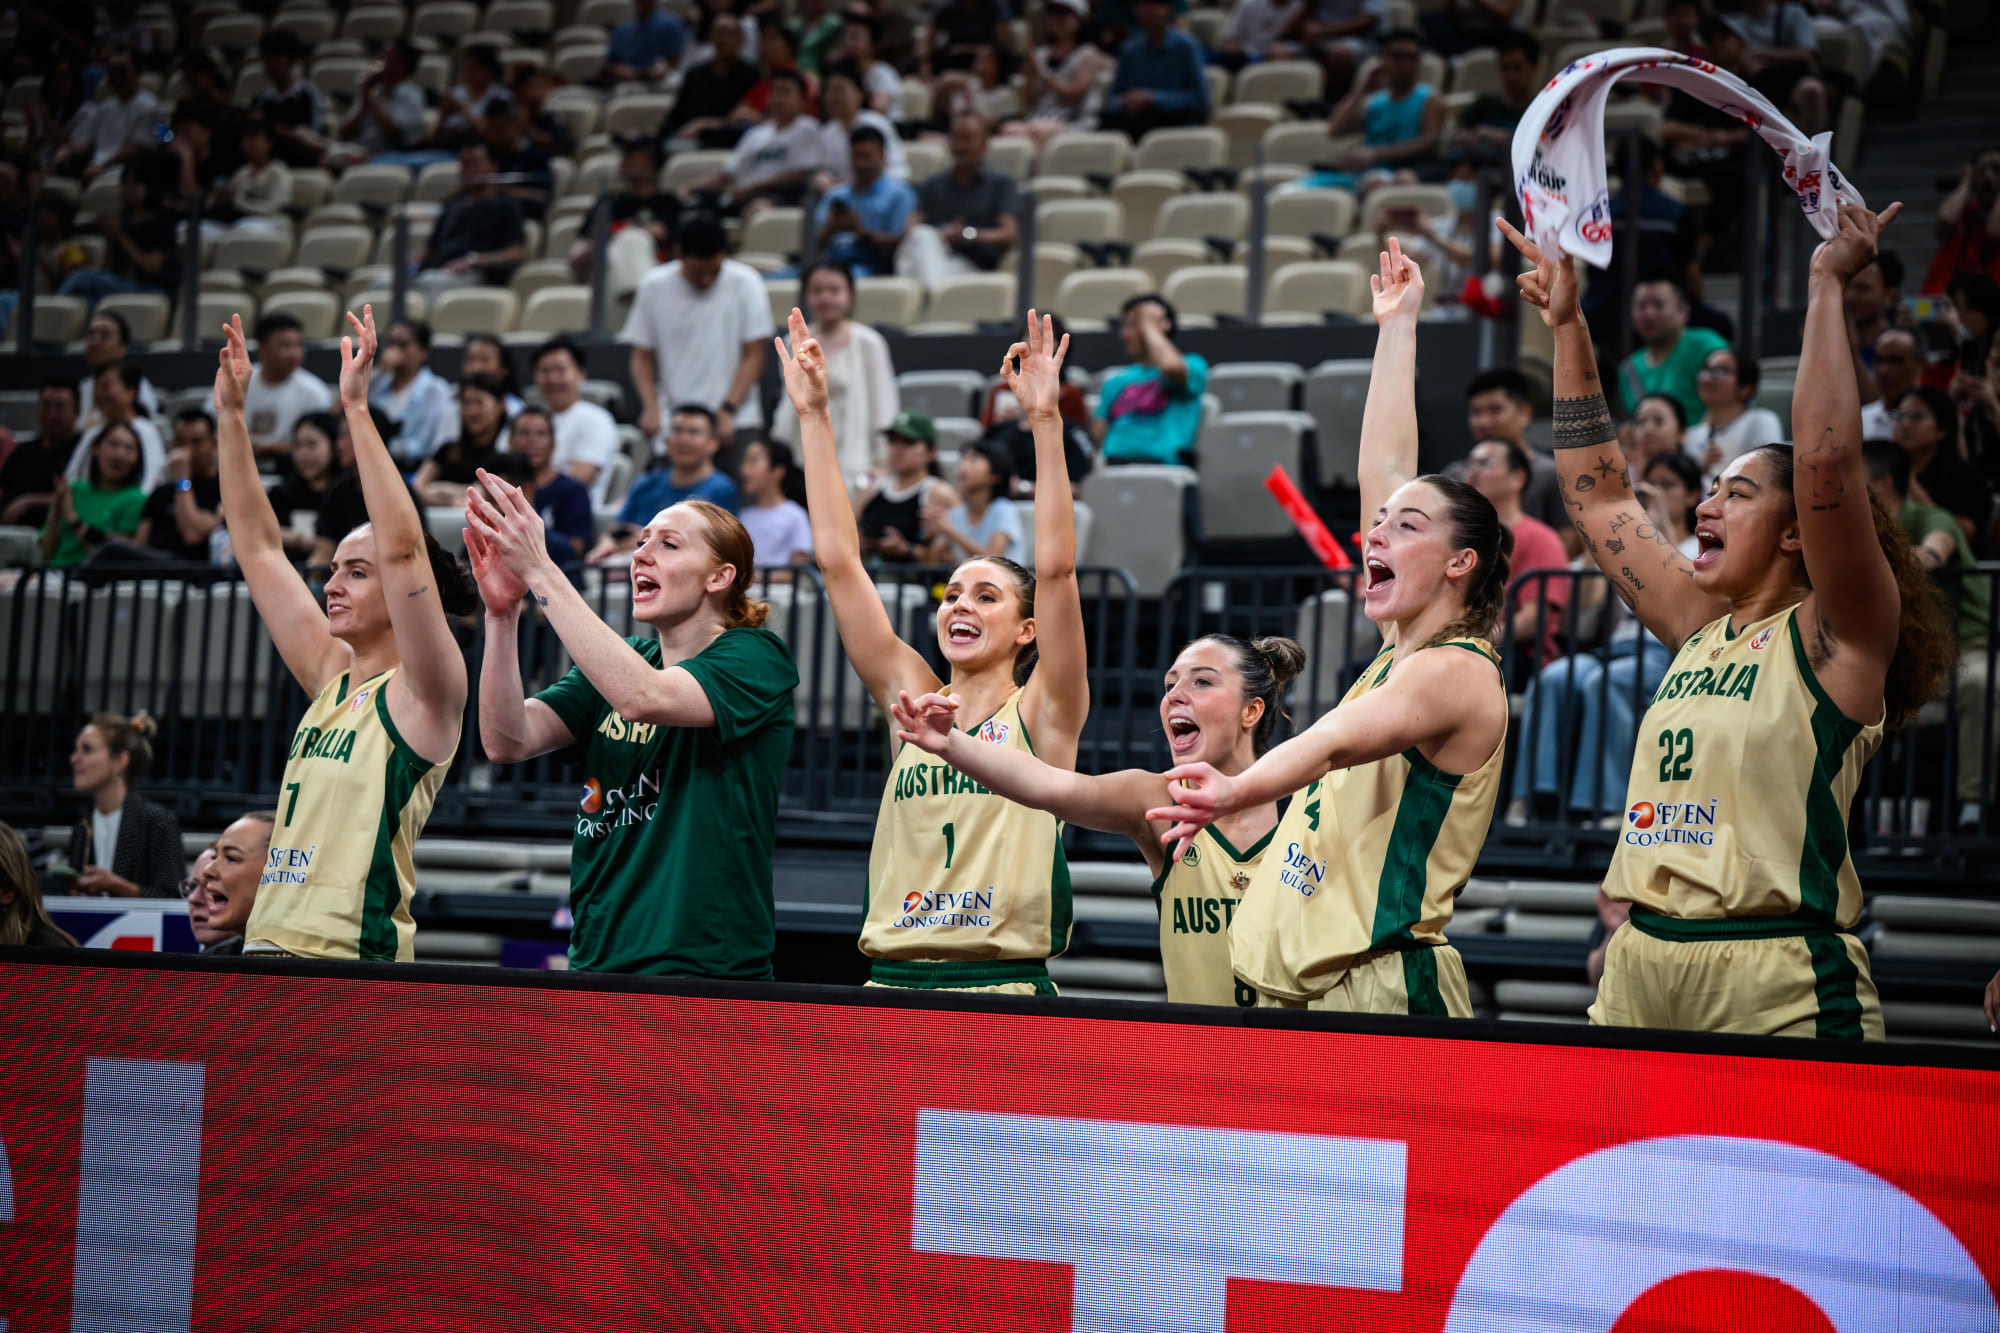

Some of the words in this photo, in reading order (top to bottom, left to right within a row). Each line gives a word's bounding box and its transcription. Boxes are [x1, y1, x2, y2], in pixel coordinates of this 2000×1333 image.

[1659, 728, 1693, 782] 22
[894, 763, 998, 802] AUSTRA
[284, 782, 301, 828] 7
[942, 822, 955, 869] 1
[1625, 828, 1714, 847] COSLTING
[920, 890, 993, 912] SEVEN
